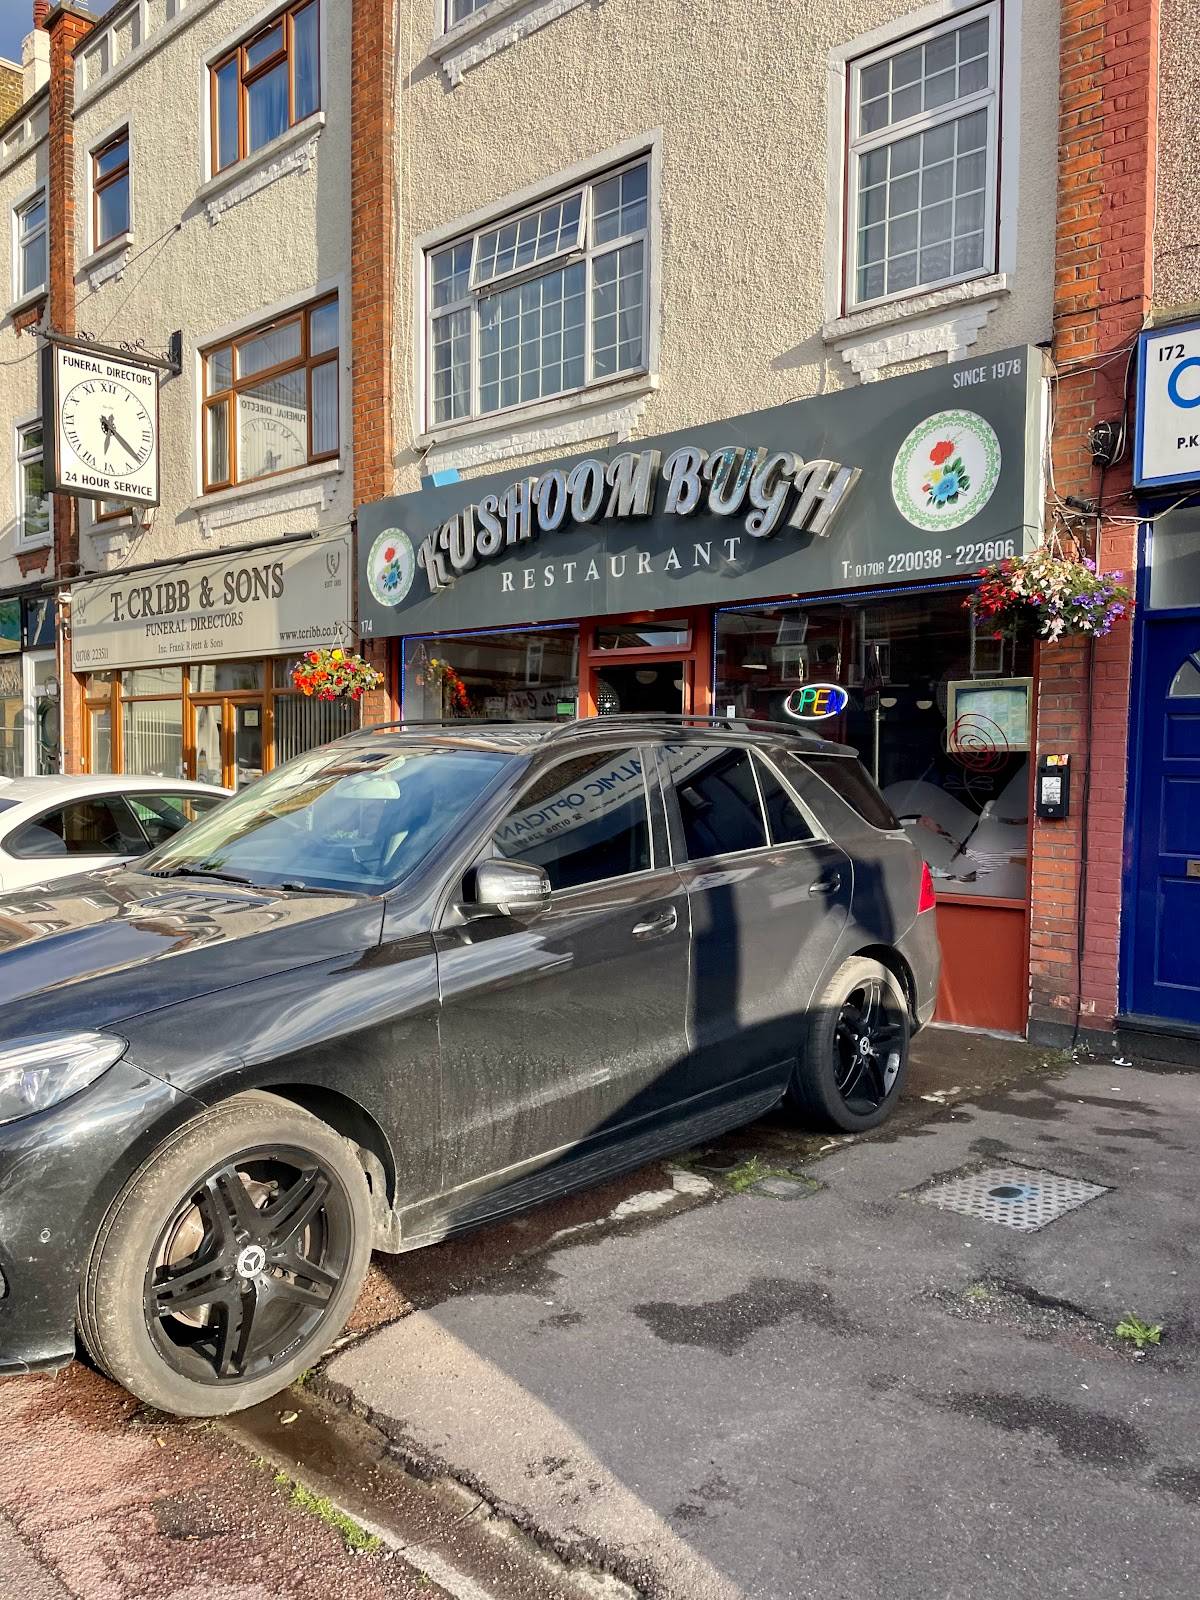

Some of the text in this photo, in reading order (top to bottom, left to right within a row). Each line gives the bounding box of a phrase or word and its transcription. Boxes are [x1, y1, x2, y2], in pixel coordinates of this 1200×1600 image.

[1159, 344, 1185, 361] 172
[63, 356, 152, 386] FUNERAL DIRECTORS
[953, 359, 1021, 389] SINCE 1978
[65, 471, 153, 496] 24 HOUR SERVICE
[417, 446, 863, 593] KUSHOOM BUGH
[501, 536, 741, 592] RESTAURANT
[855, 561, 885, 577] 01708
[887, 548, 942, 574] 220038
[955, 539, 1015, 566] 222606
[199, 575, 215, 609] &
[223, 562, 284, 606] SONS
[145, 612, 243, 637] FUNERAL DIRECTORS
[360, 620, 373, 633] 174
[169, 642, 185, 652] Frank
[203, 639, 209, 649] &
[210, 638, 224, 649] Sons
[788, 688, 845, 715] OPEN
